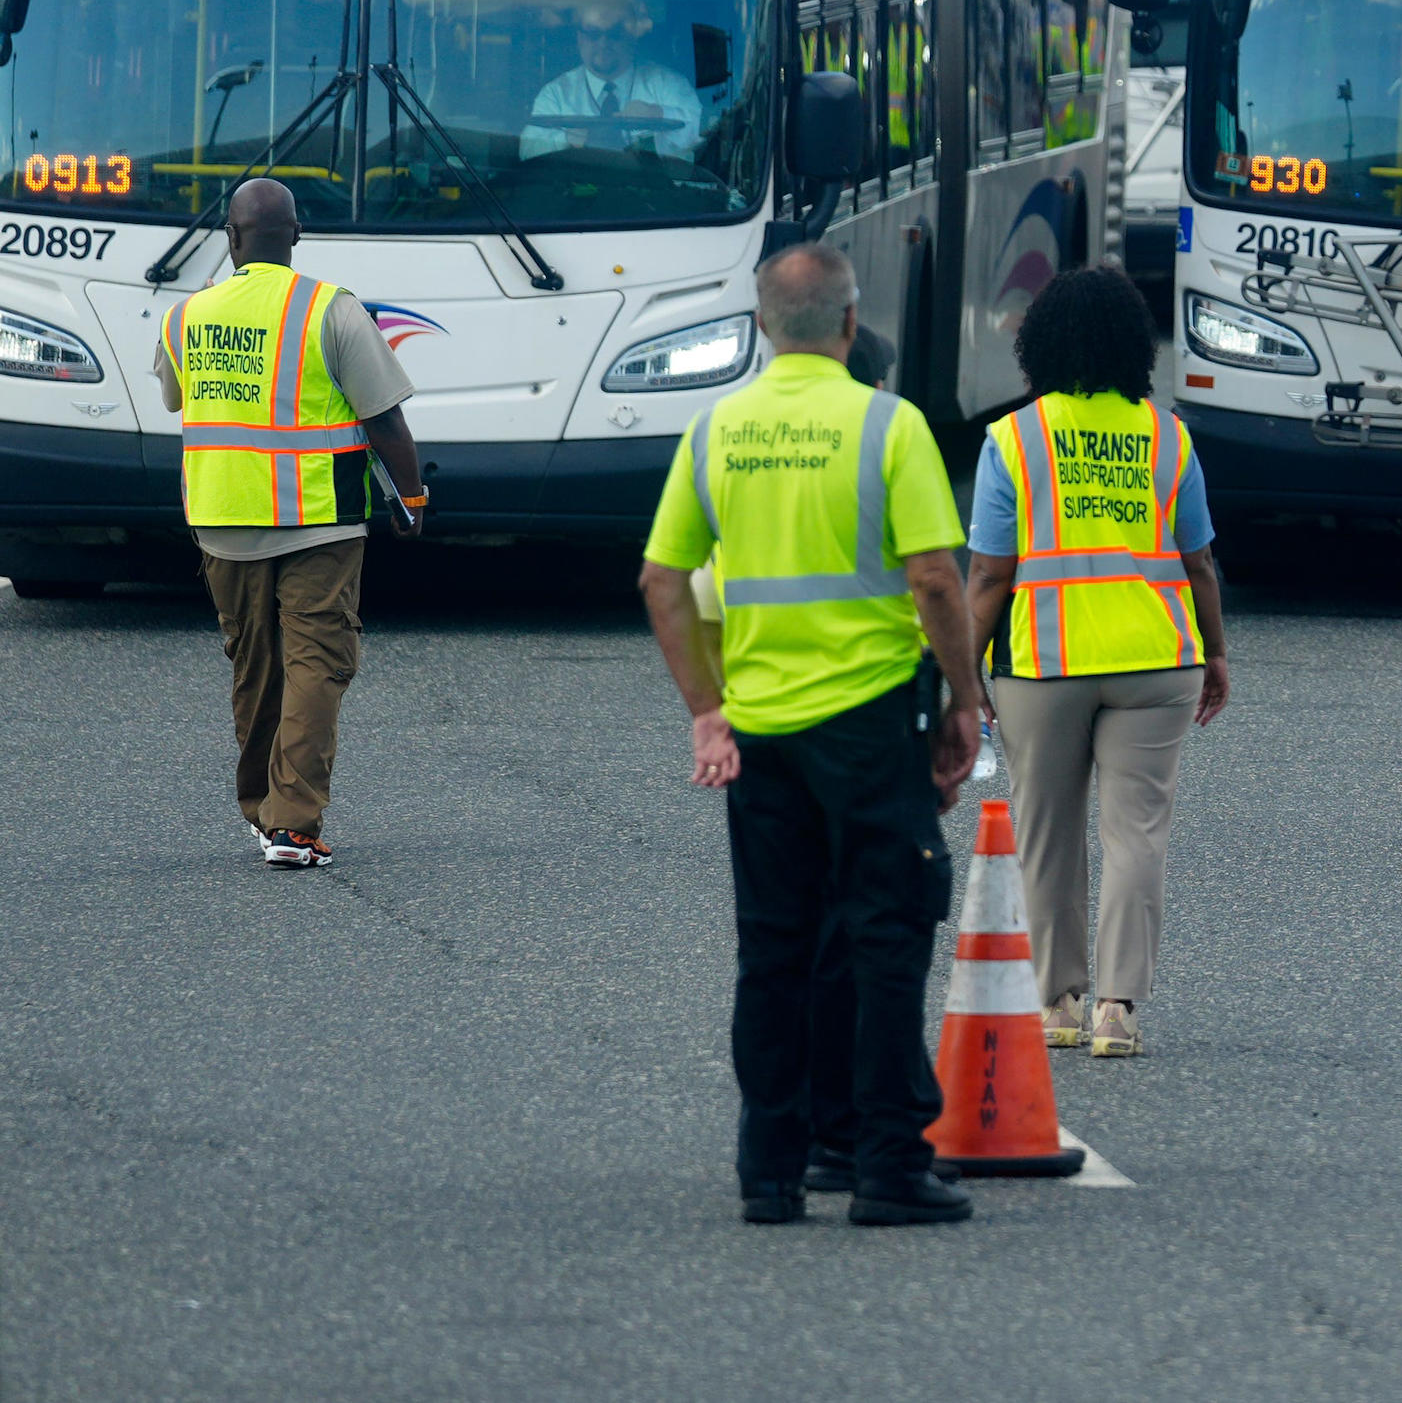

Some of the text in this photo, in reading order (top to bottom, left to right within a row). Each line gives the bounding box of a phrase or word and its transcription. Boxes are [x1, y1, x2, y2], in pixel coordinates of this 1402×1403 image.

[25, 153, 131, 194] 0913
[0, 222, 117, 261] 20897
[187, 324, 267, 353] NJ TRANSIT
[204, 354, 265, 375] OPERATIONS
[720, 420, 842, 450] Traffic/Parking
[1054, 429, 1151, 464] NJ TRANSIT
[725, 449, 830, 474] Supervisor
[1059, 461, 1081, 484] BUS
